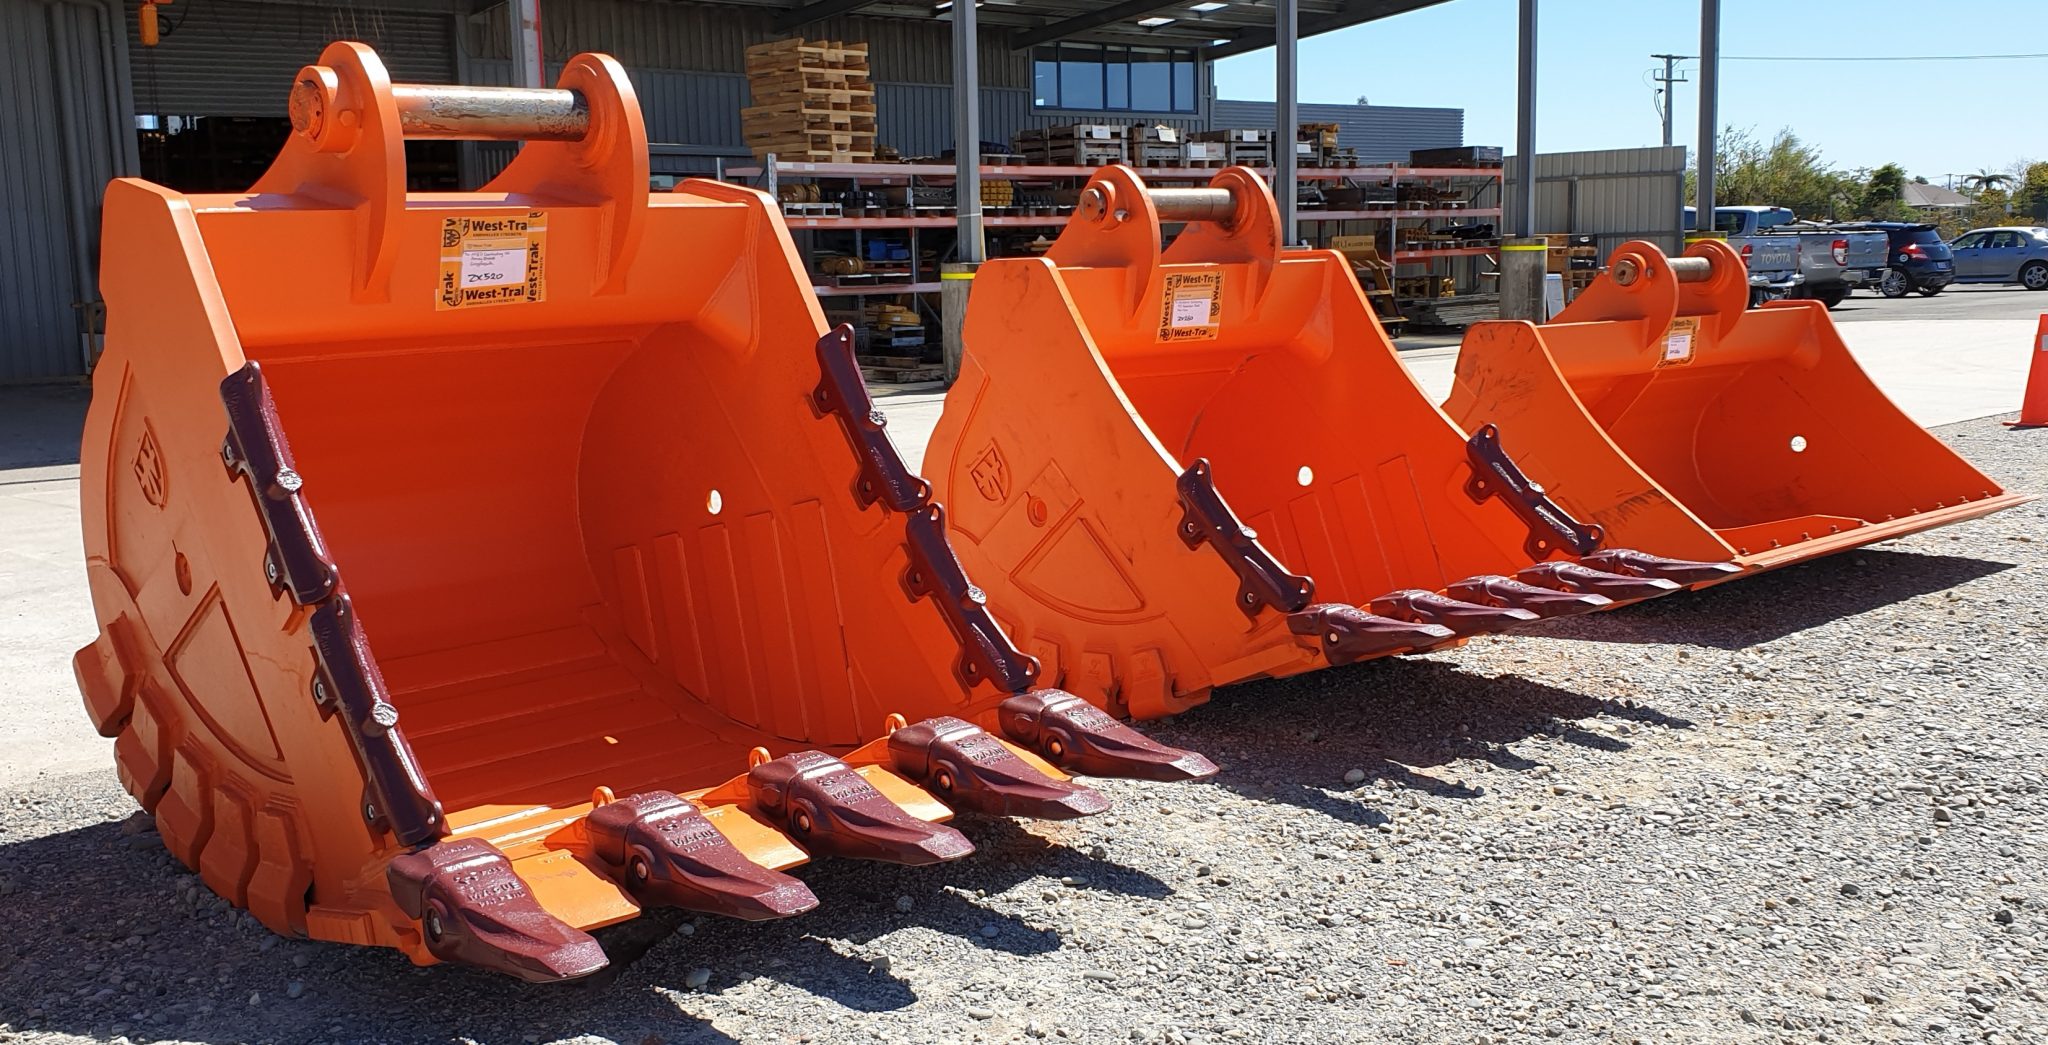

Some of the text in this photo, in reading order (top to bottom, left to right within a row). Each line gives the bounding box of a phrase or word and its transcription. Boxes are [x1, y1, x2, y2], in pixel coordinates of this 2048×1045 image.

[472, 220, 528, 231] West-Tra
[1761, 253, 1791, 264] TOYOTA
[1183, 274, 1214, 283] West-Tr
[1174, 328, 1207, 337] West-Tra
